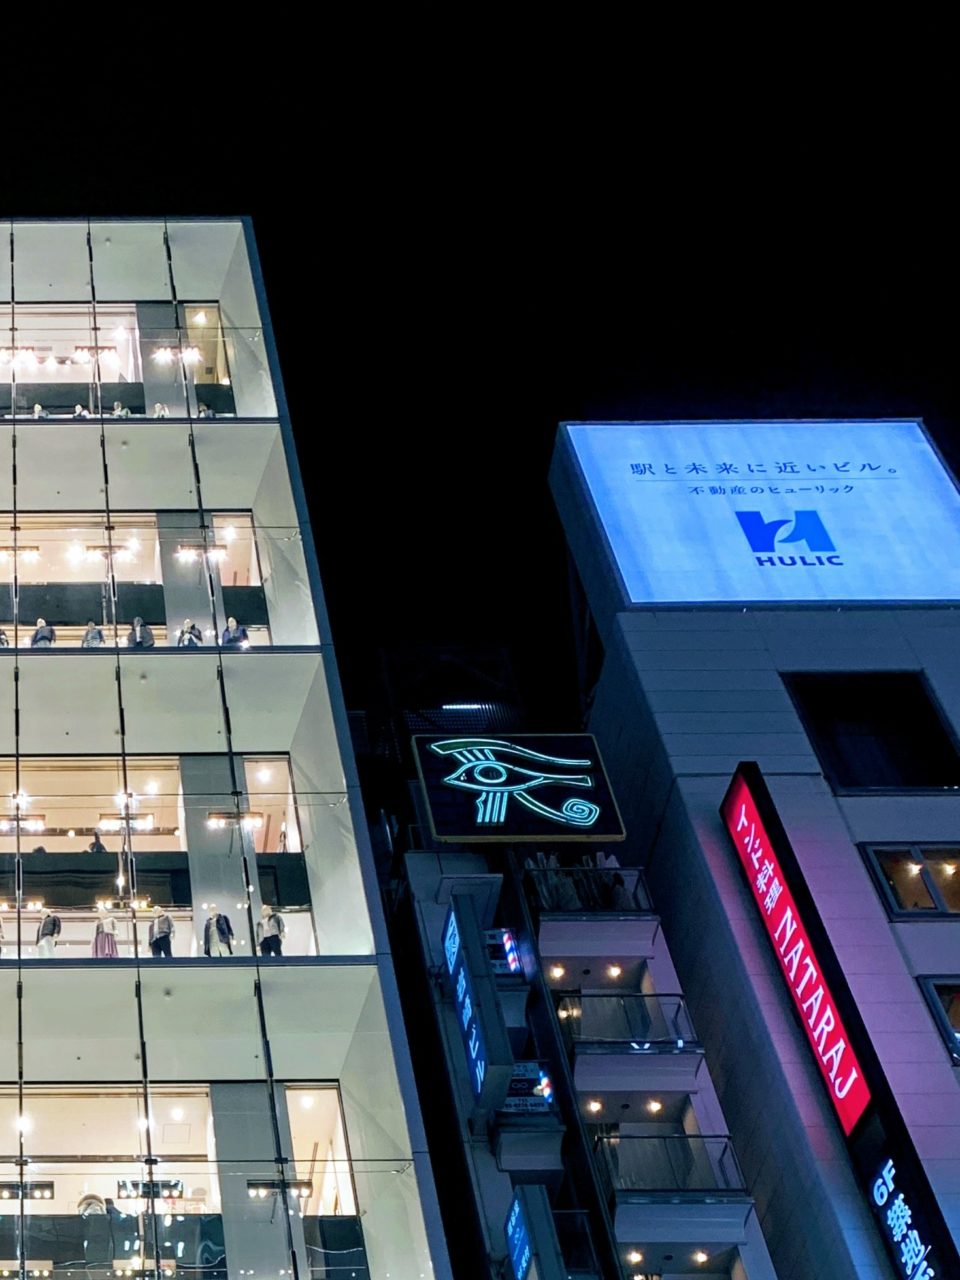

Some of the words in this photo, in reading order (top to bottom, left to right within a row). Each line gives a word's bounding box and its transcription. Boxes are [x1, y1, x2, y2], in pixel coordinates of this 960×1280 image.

[630, 461, 897, 475] 駅と未来に近いビル。
[690, 484, 854, 495] 不動産のヒューリック
[756, 555, 844, 566] HULIC
[737, 804, 783, 915] インド料理
[774, 906, 858, 1099] NATARAJ
[873, 1159, 896, 1206] 6F
